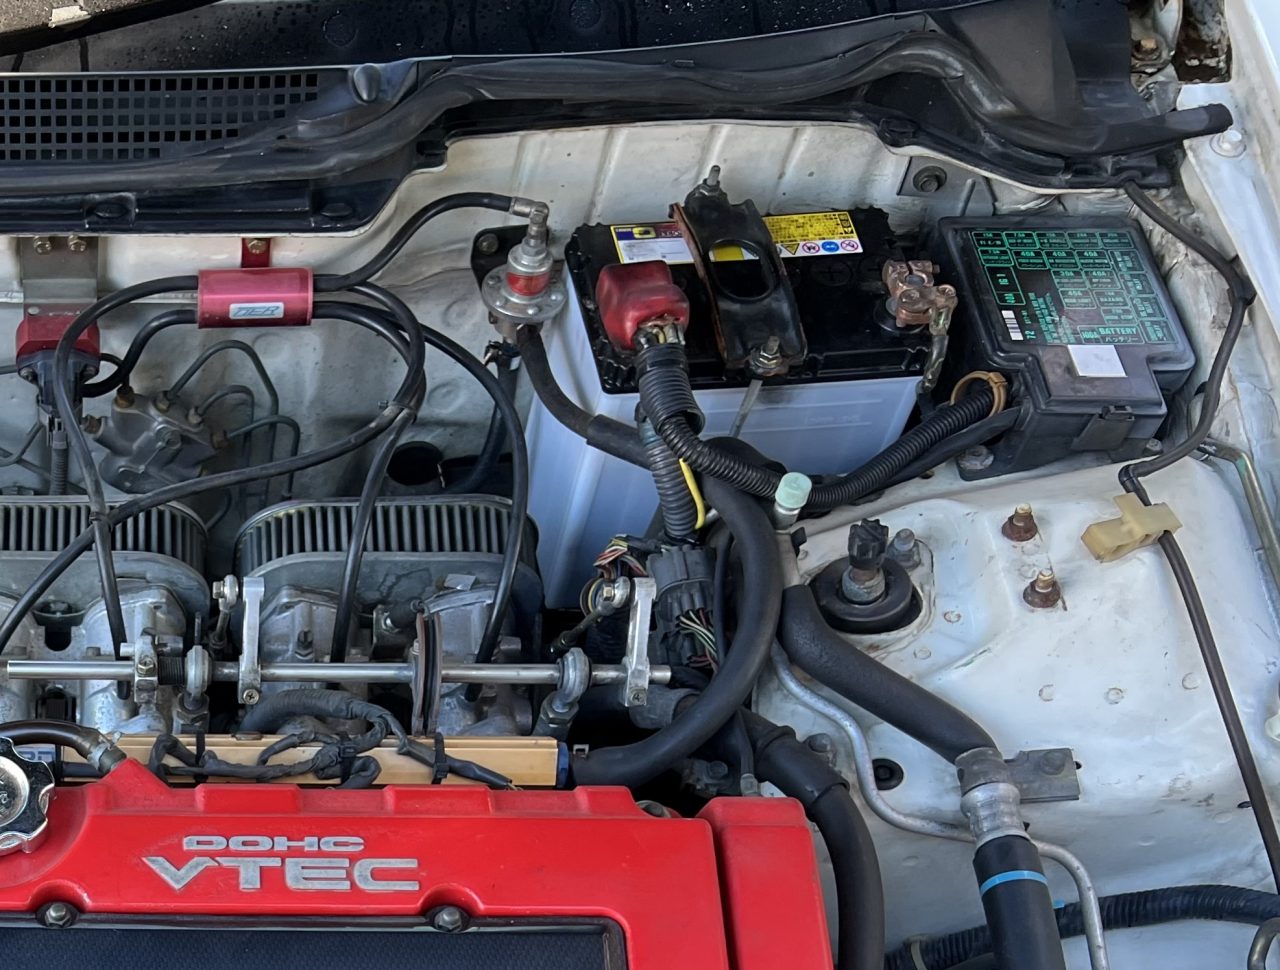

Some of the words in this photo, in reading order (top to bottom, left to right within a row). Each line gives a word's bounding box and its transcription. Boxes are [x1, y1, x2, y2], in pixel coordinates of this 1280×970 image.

[1098, 327, 1137, 335] BATTERY
[183, 835, 365, 851] DOHC
[142, 856, 420, 893] VTEC
